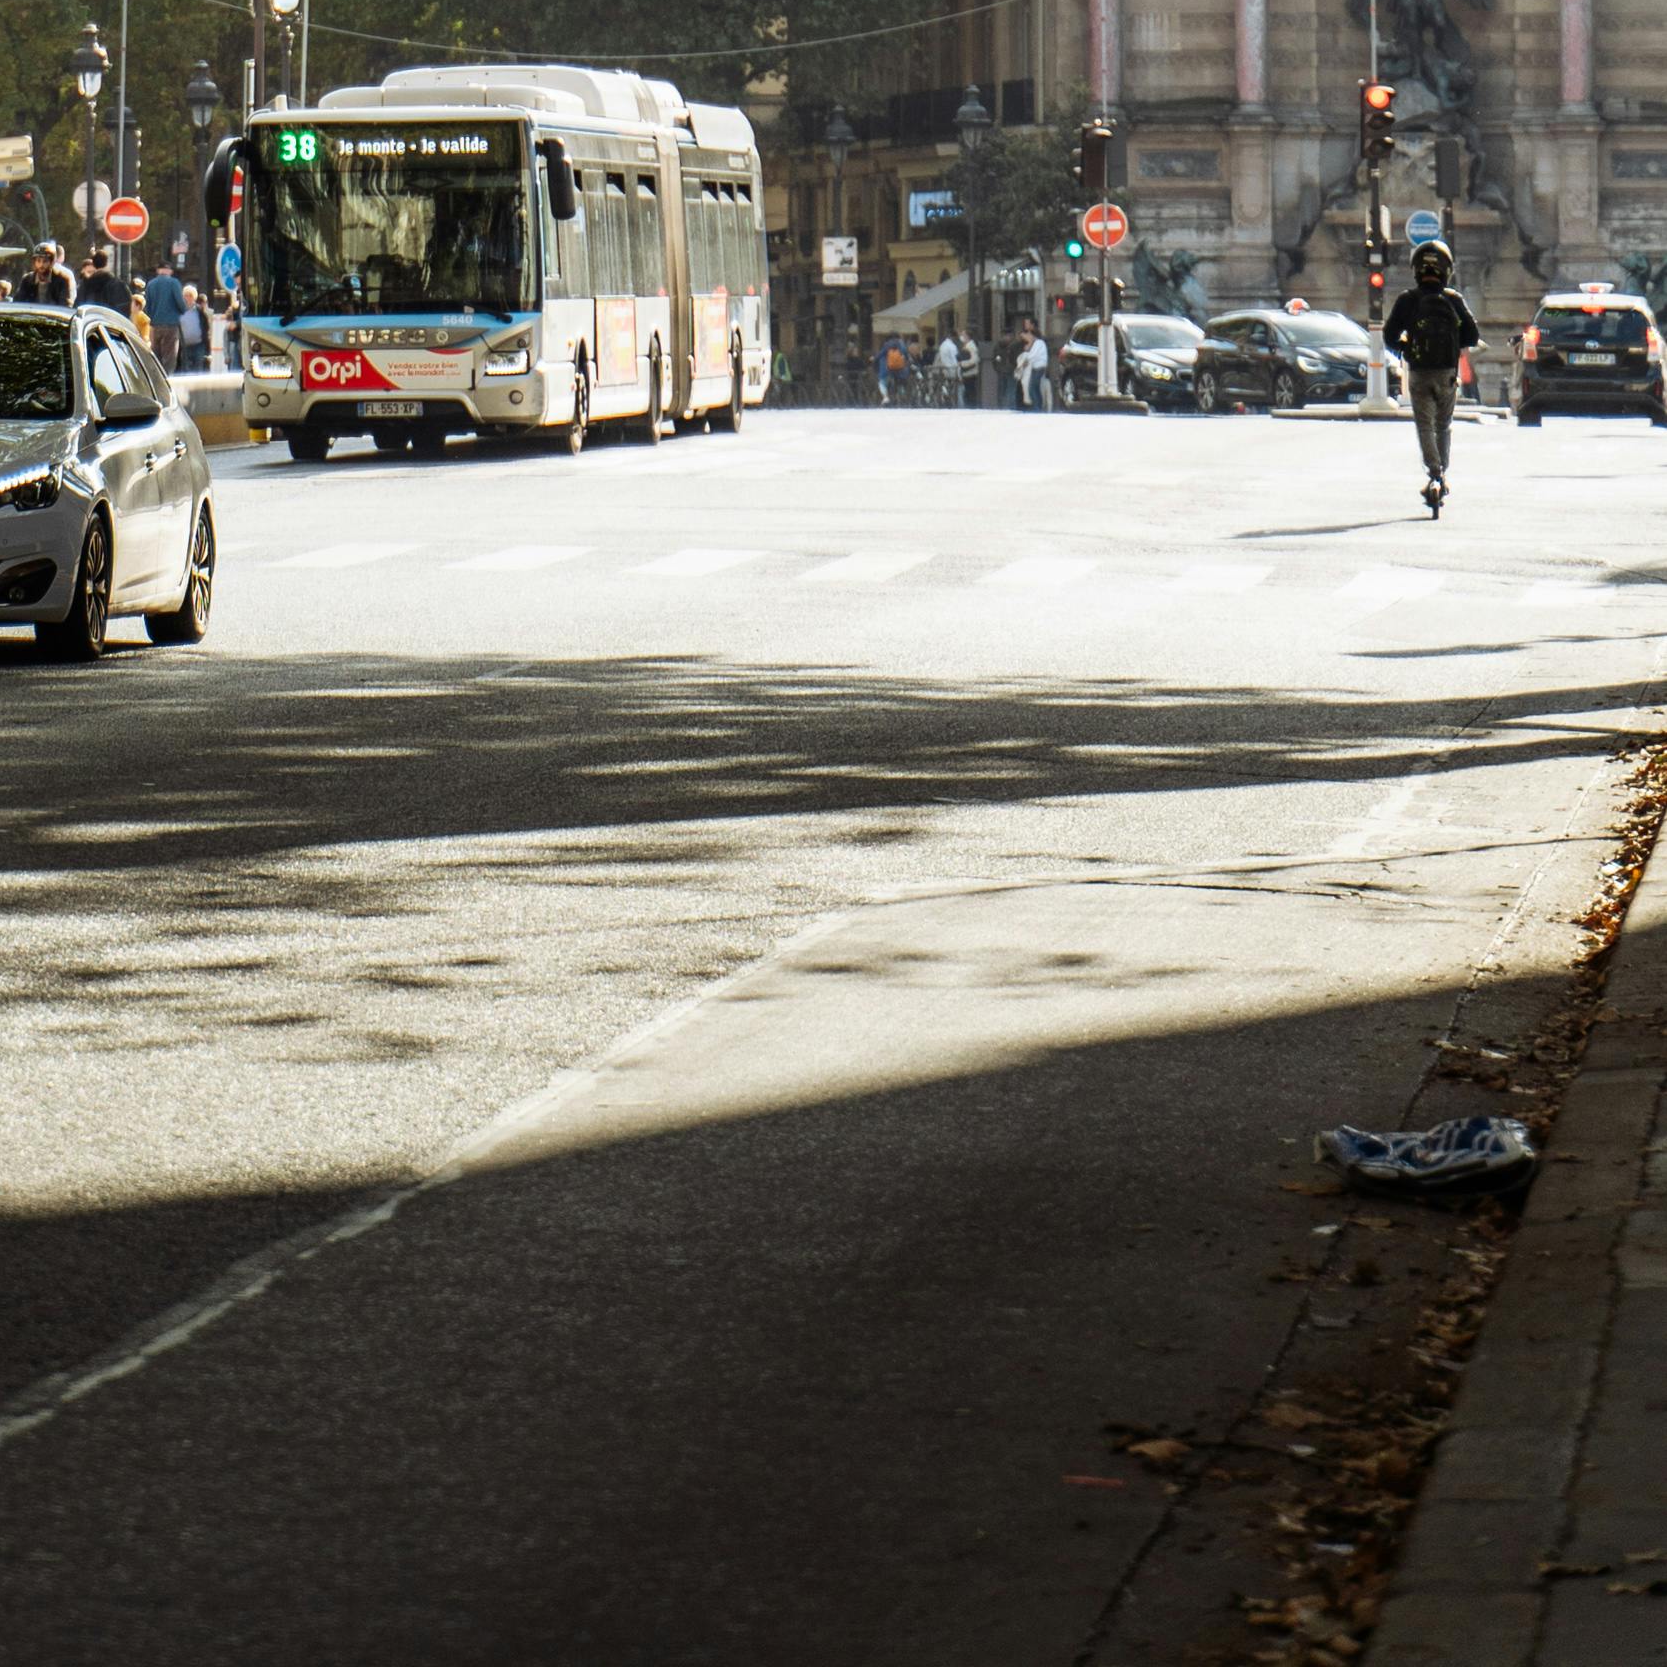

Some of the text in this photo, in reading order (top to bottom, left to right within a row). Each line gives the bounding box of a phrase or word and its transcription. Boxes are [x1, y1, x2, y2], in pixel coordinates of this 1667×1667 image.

[281, 134, 317, 161] 38
[338, 136, 488, 155] Je monte Je valide
[348, 328, 427, 344] IVECO
[308, 355, 362, 385] Orpi
